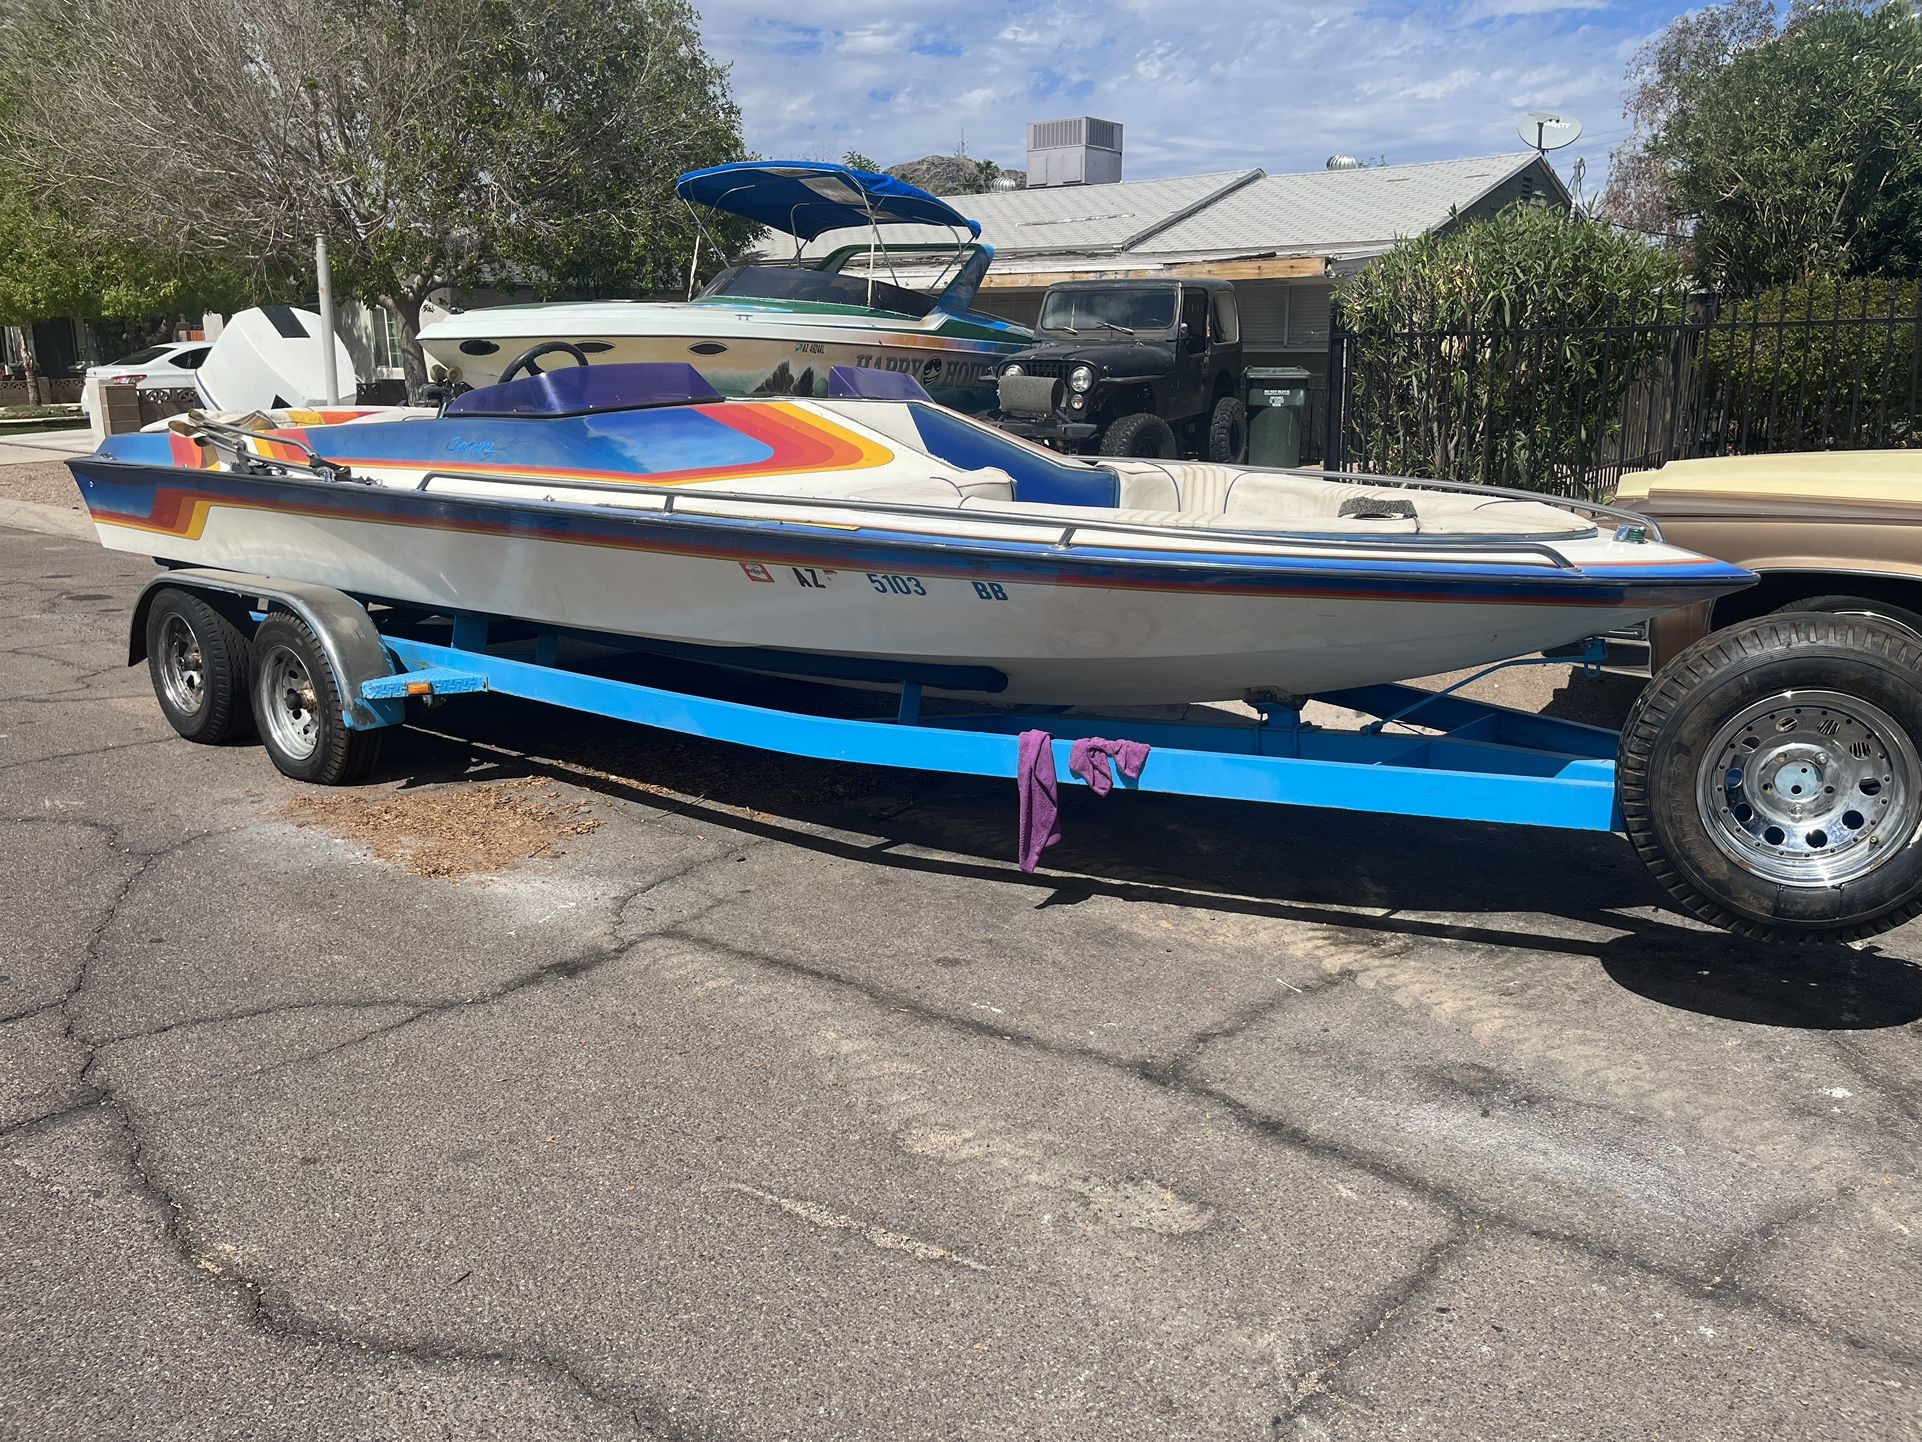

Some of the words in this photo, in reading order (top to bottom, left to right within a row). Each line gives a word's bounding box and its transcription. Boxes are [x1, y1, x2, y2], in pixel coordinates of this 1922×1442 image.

[792, 567, 826, 588] AZ
[866, 573, 927, 596] 5103
[971, 581, 1009, 601] BB
